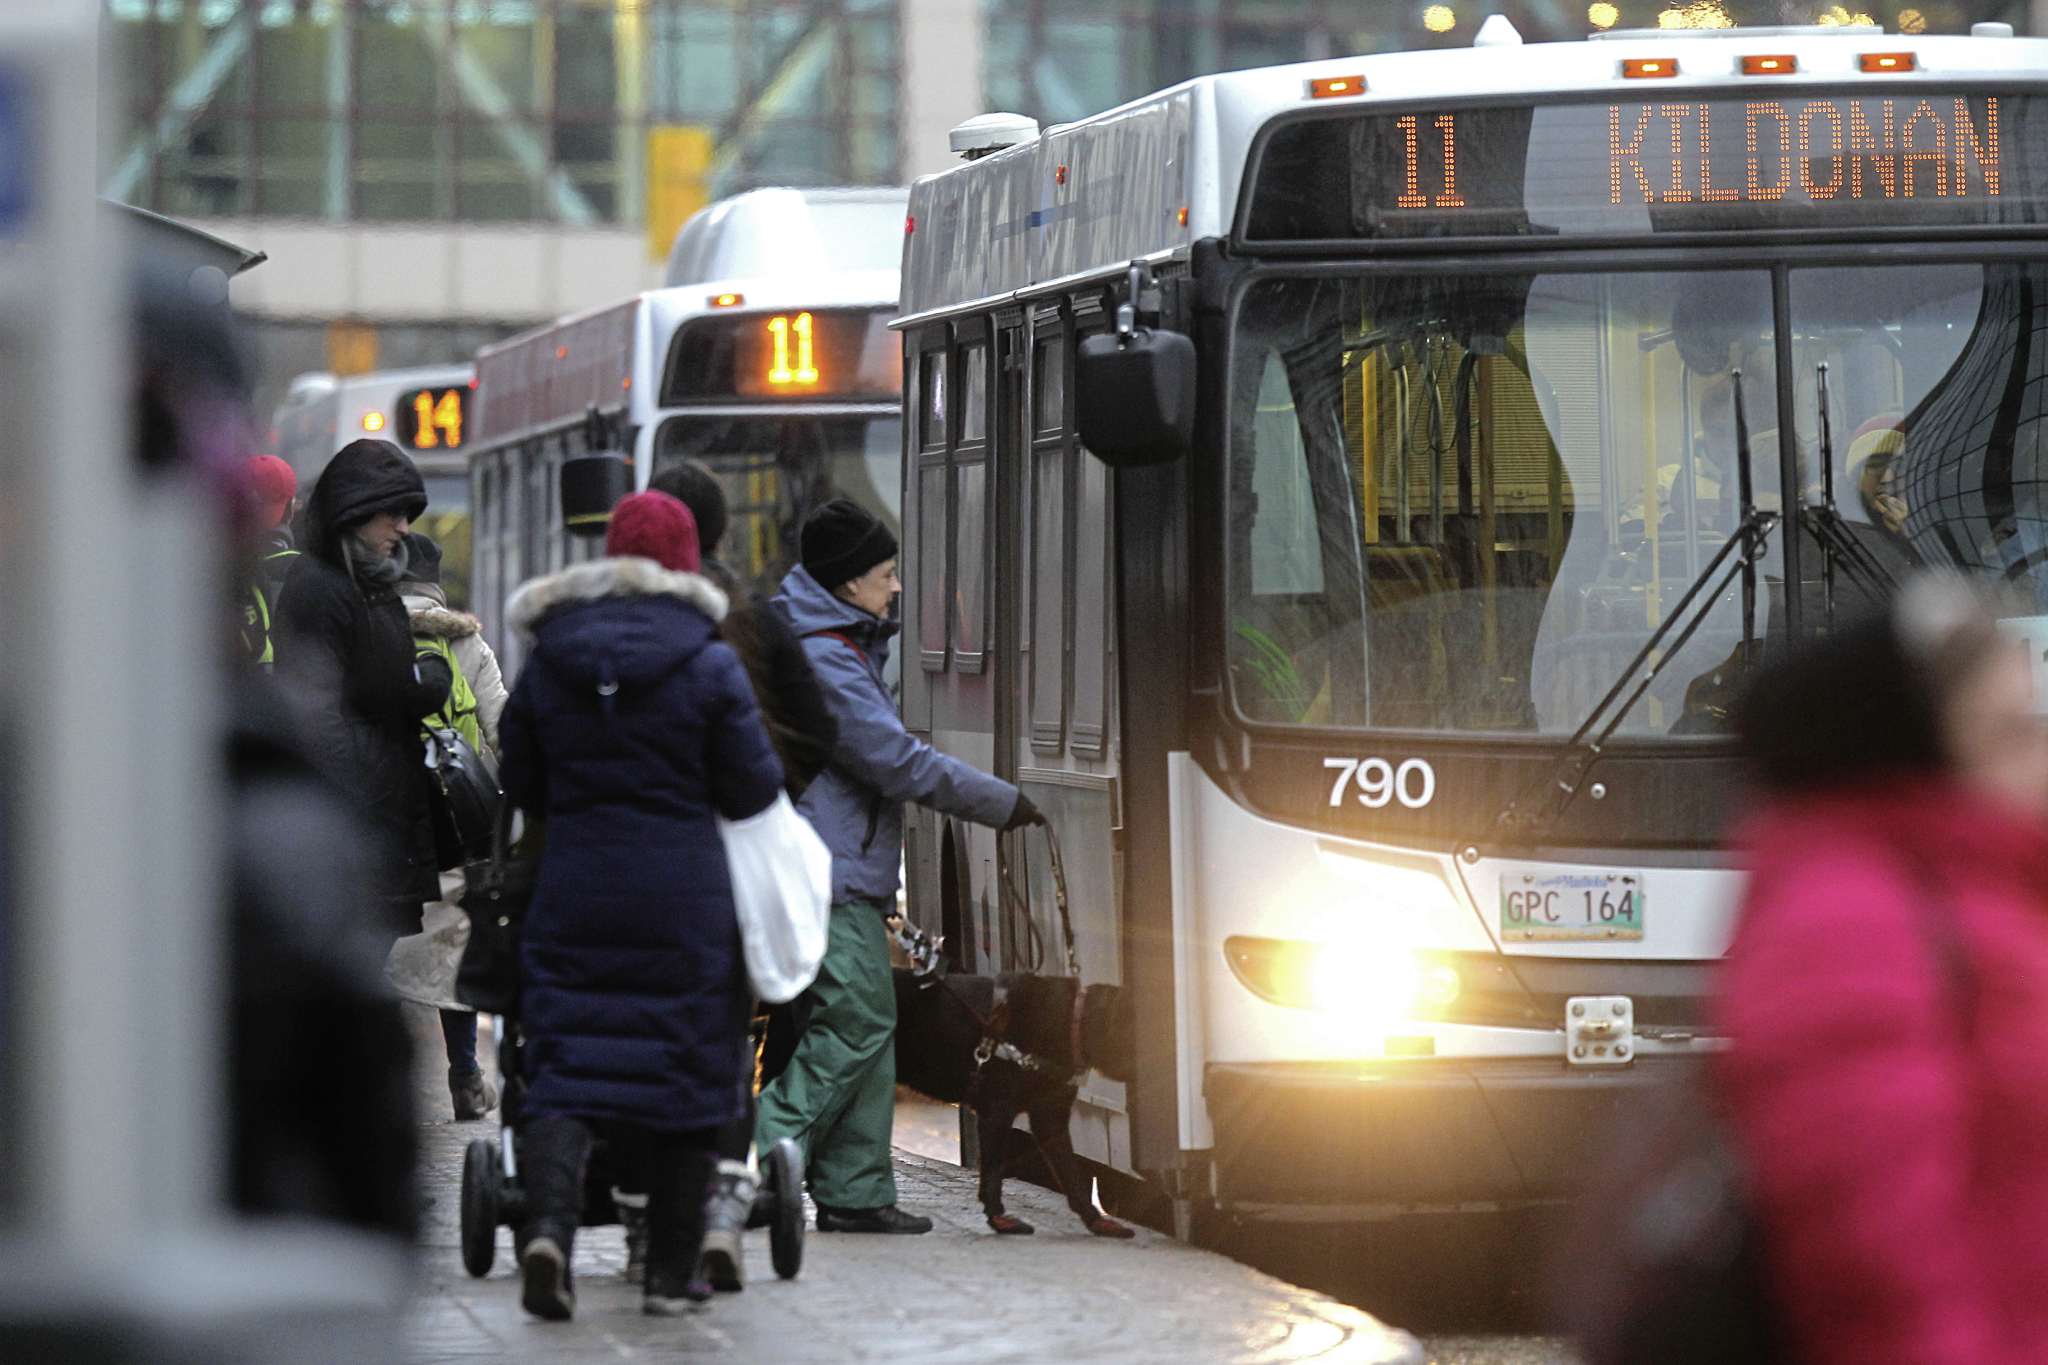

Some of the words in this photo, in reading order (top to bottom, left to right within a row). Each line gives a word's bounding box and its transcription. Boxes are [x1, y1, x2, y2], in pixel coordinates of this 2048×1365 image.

[1396, 114, 1465, 208] 11
[1607, 97, 2001, 204] KILDONAN
[768, 312, 820, 385] 11
[414, 389, 464, 449] 14
[1323, 757, 1436, 809] 790
[1507, 890, 1560, 923] GPC
[1583, 889, 1635, 922] 164
